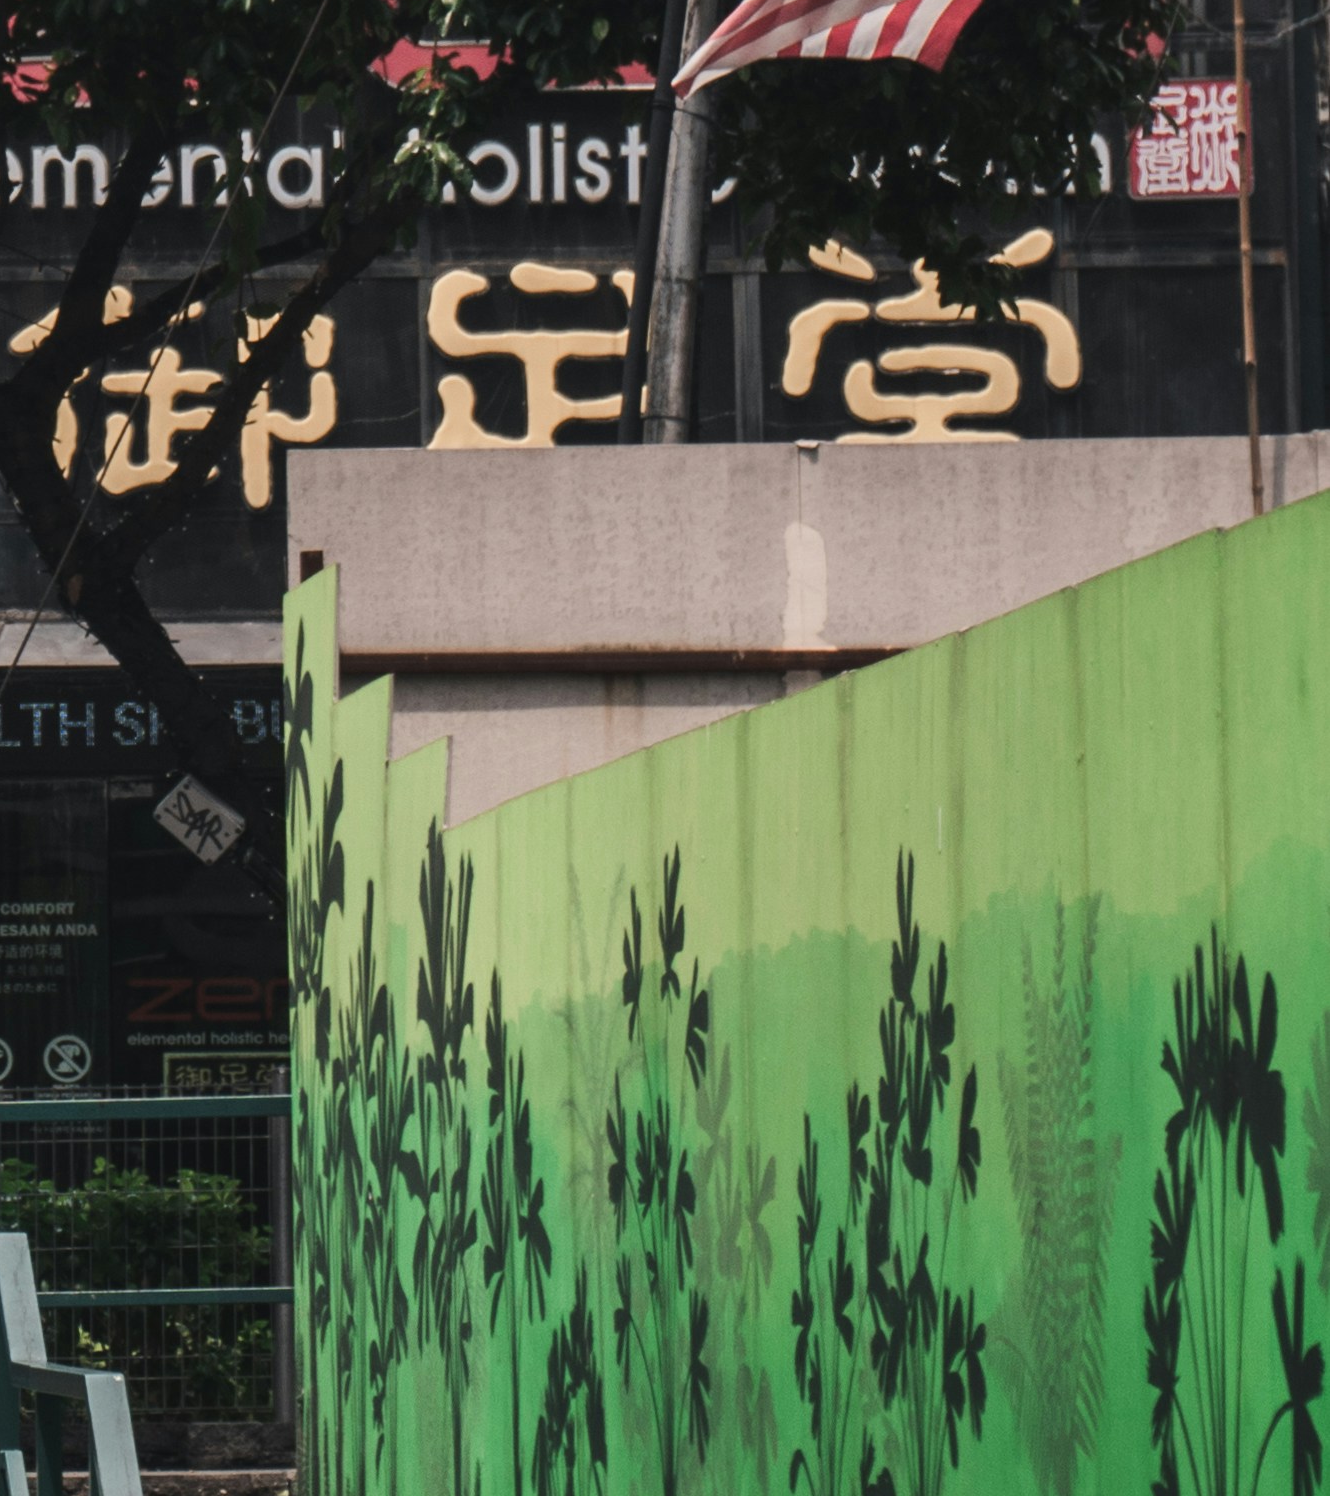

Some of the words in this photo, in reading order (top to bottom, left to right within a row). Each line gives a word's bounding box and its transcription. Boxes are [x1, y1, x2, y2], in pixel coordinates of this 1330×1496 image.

[0, 901, 76, 916] COMFORT
[54, 923, 99, 938] ANDA
[126, 1031, 206, 1046] elemental
[210, 1031, 265, 1046] holistic
[269, 1031, 289, 1045] he
